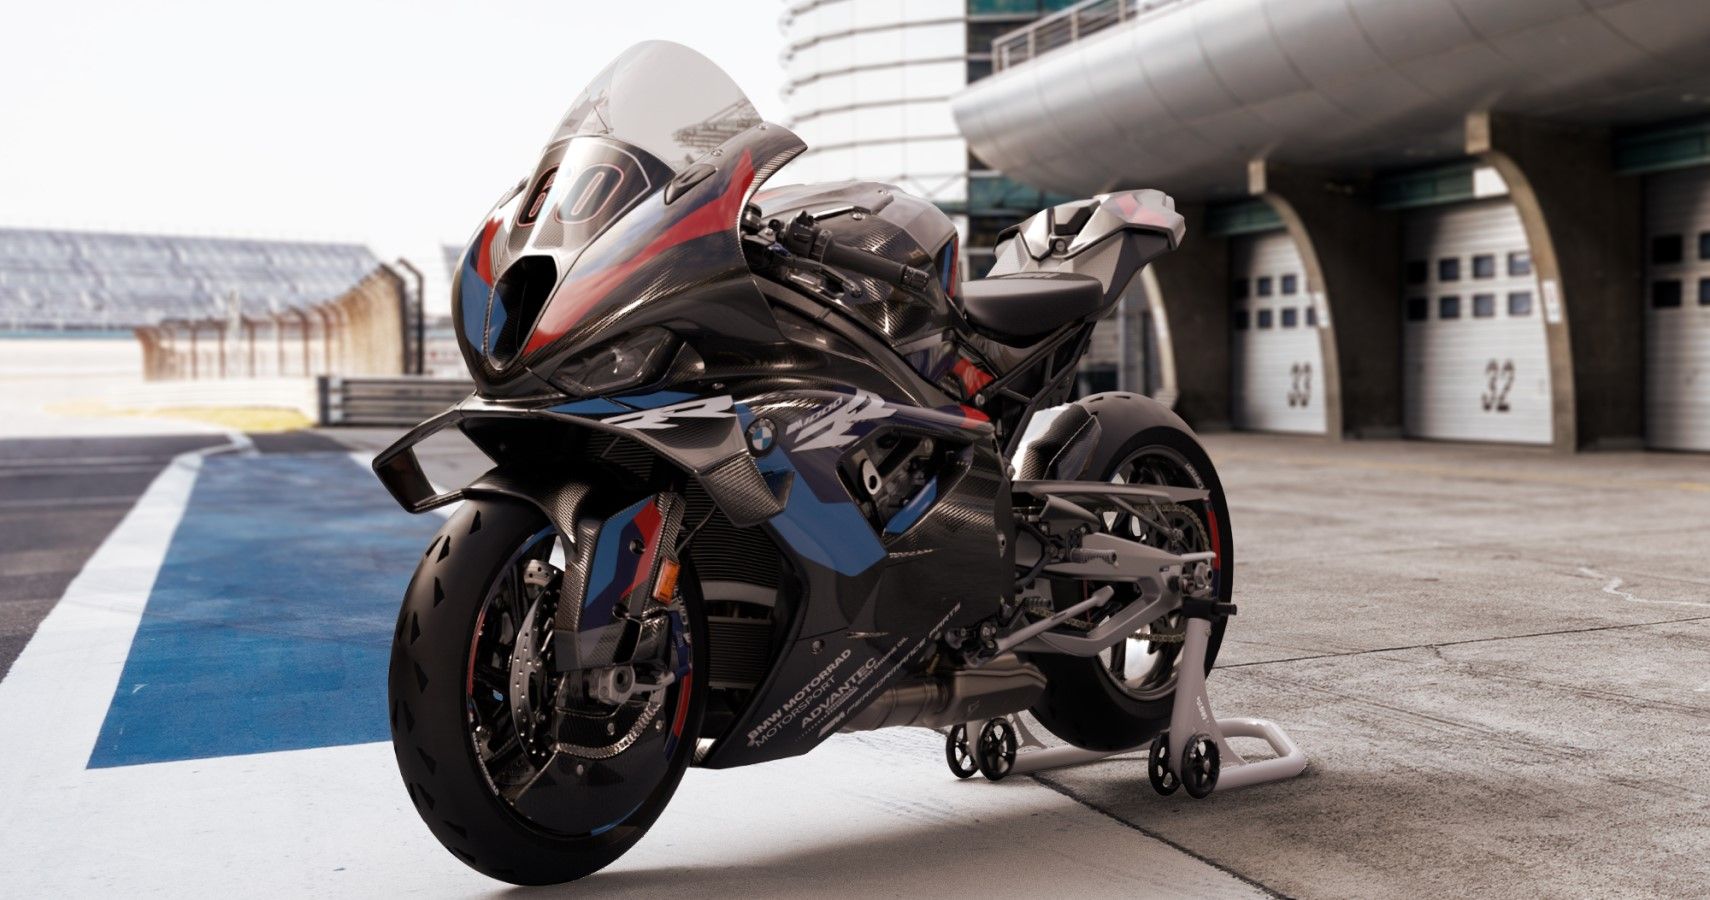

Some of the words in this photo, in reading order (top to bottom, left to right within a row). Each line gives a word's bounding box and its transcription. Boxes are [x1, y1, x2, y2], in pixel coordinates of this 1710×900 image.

[517, 163, 625, 227] 60
[1287, 362, 1312, 407] 33
[1482, 360, 1514, 412] 32
[801, 657, 877, 729] ADVANTEC
[847, 637, 927, 713] PERFORMANCE
[928, 602, 961, 639] PARTS
[747, 708, 782, 741] BMW
[783, 648, 851, 711] MOTORRAD
[754, 676, 835, 748] MOTORSPORT
